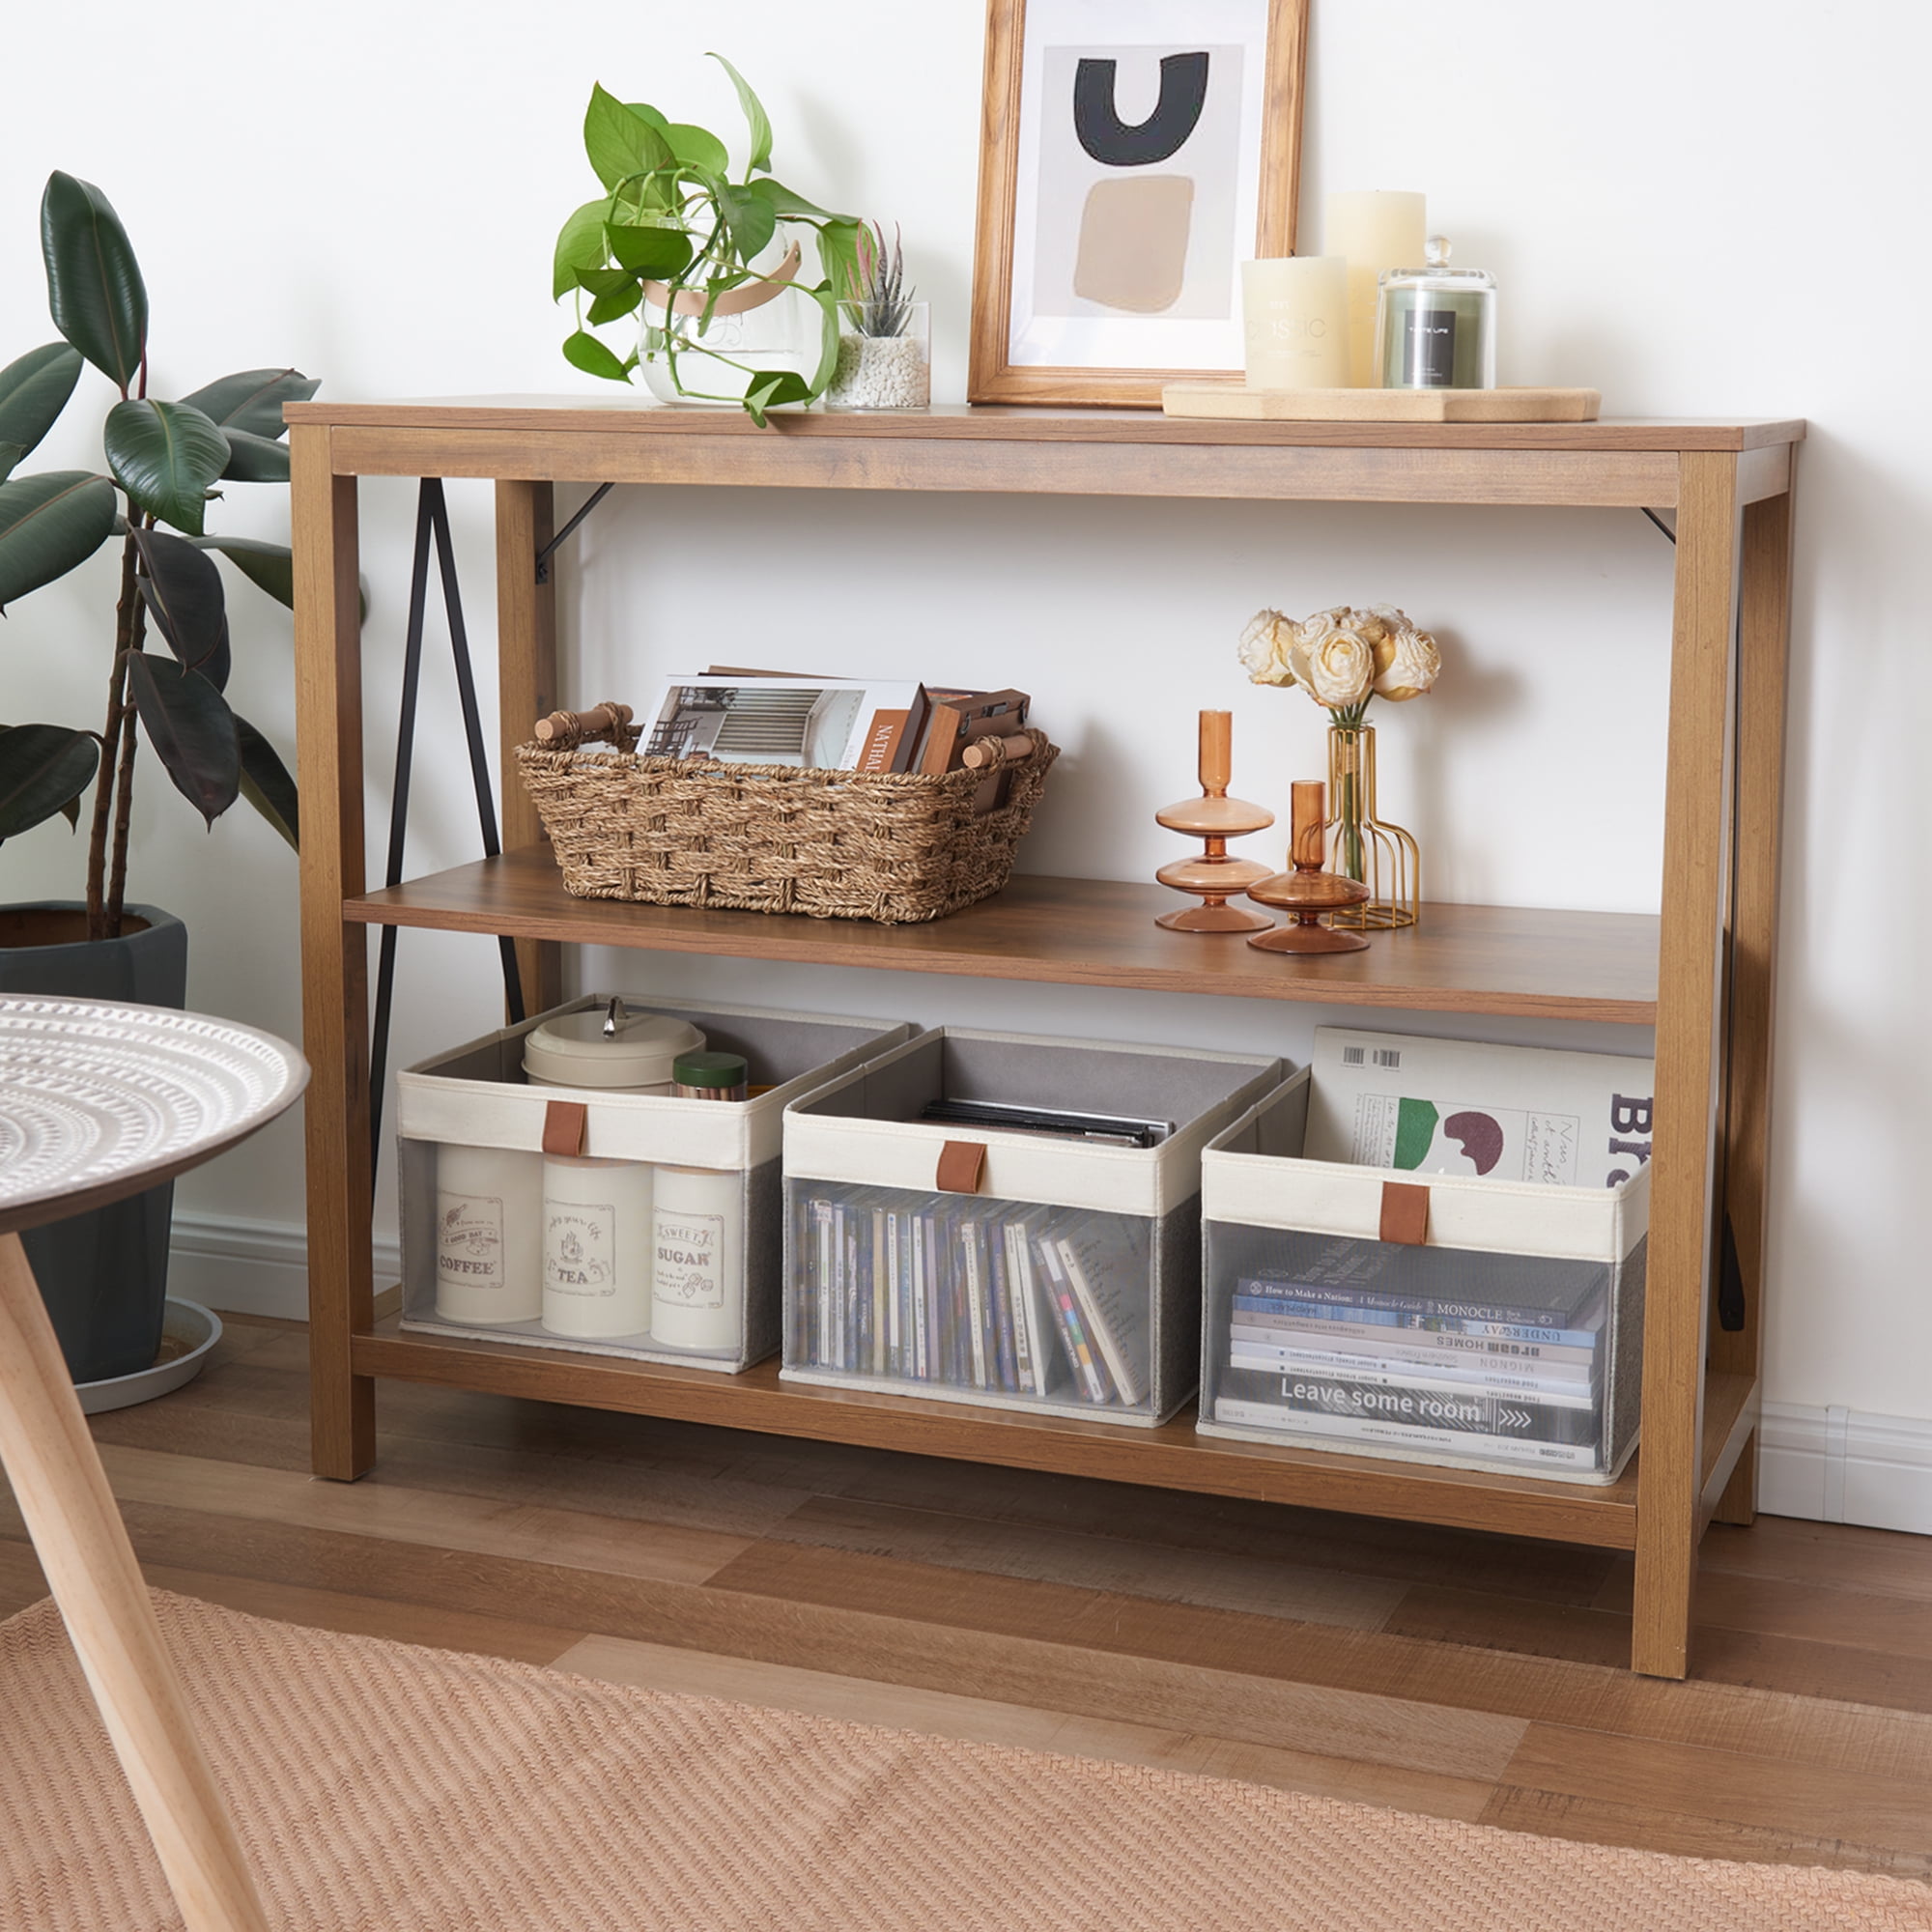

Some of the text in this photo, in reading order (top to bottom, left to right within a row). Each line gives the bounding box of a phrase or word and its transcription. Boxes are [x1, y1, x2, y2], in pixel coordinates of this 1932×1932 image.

[440, 1254, 495, 1275] COFFEE
[657, 1246, 710, 1266] SUGAR
[557, 1267, 588, 1285] TEA
[1265, 1285, 1283, 1295] How
[1285, 1288, 1293, 1296] to
[1294, 1288, 1317, 1299] Make
[1437, 1303, 1503, 1321] MONOCLE
[1436, 1335, 1485, 1350] HOMES
[1479, 1357, 1534, 1373] MIGNON
[1280, 1377, 1481, 1422] Leave some room
